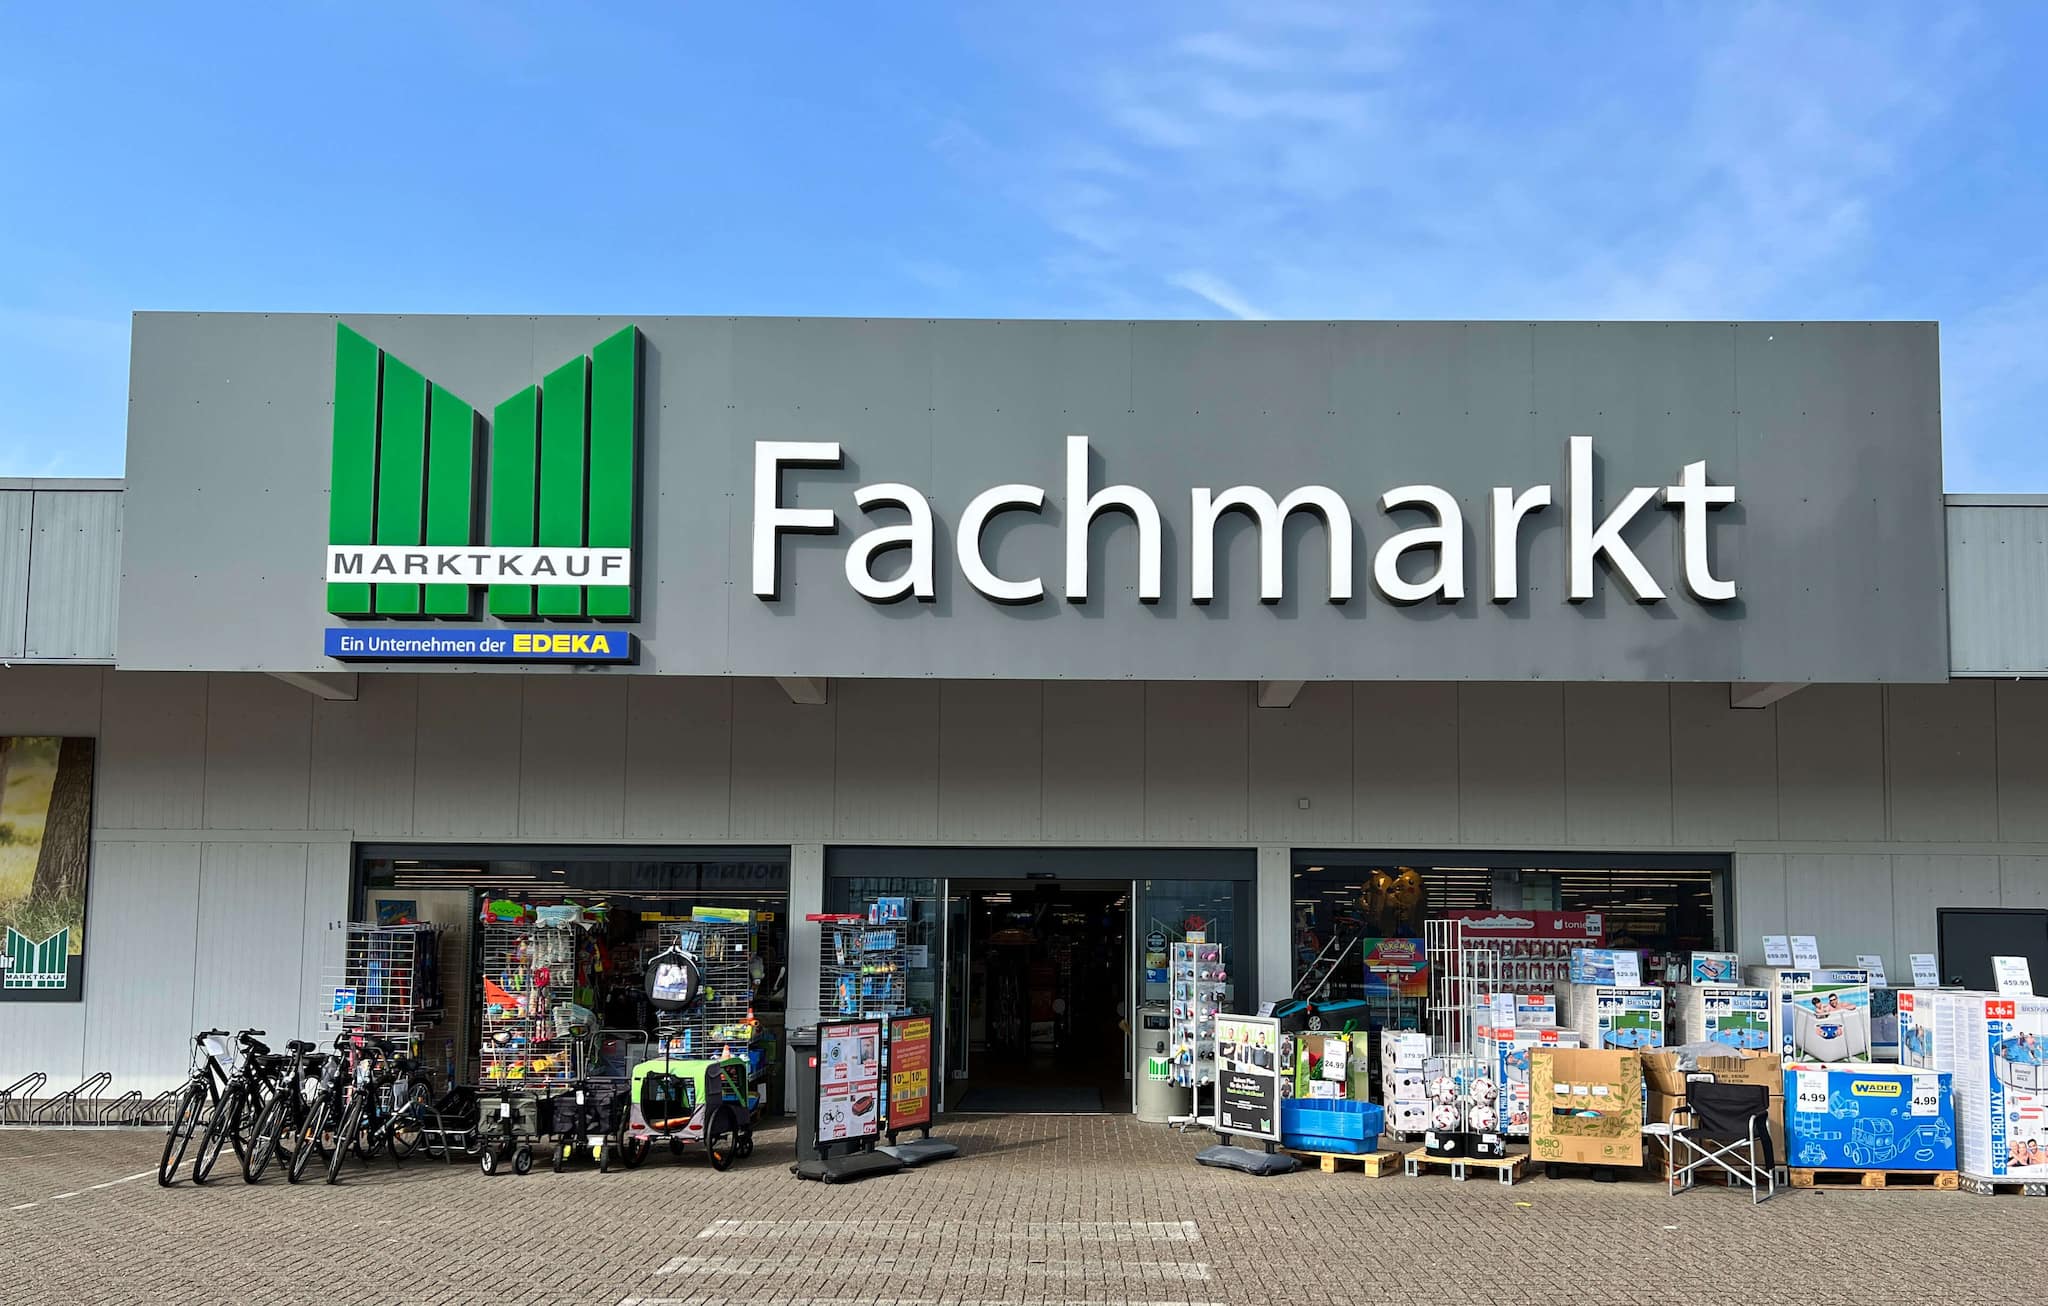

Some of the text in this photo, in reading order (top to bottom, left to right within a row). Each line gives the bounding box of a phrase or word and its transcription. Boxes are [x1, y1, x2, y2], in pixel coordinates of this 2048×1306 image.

[752, 434, 1738, 603] Fachmarkt
[333, 552, 623, 577] MARKTKAUF
[340, 633, 611, 655] Ein Unternehmen der EDEKA
[1987, 1006, 2006, 1015] 3.96
[1324, 1059, 1345, 1070] 24.99
[1855, 1083, 1898, 1093] WADER
[1799, 1093, 1826, 1103] 4.99
[1913, 1096, 1937, 1106] 4.99
[1543, 1138, 1560, 1148] BIO
[1541, 1147, 1561, 1158] BALL
[1992, 1137, 2006, 1169] STEEL
